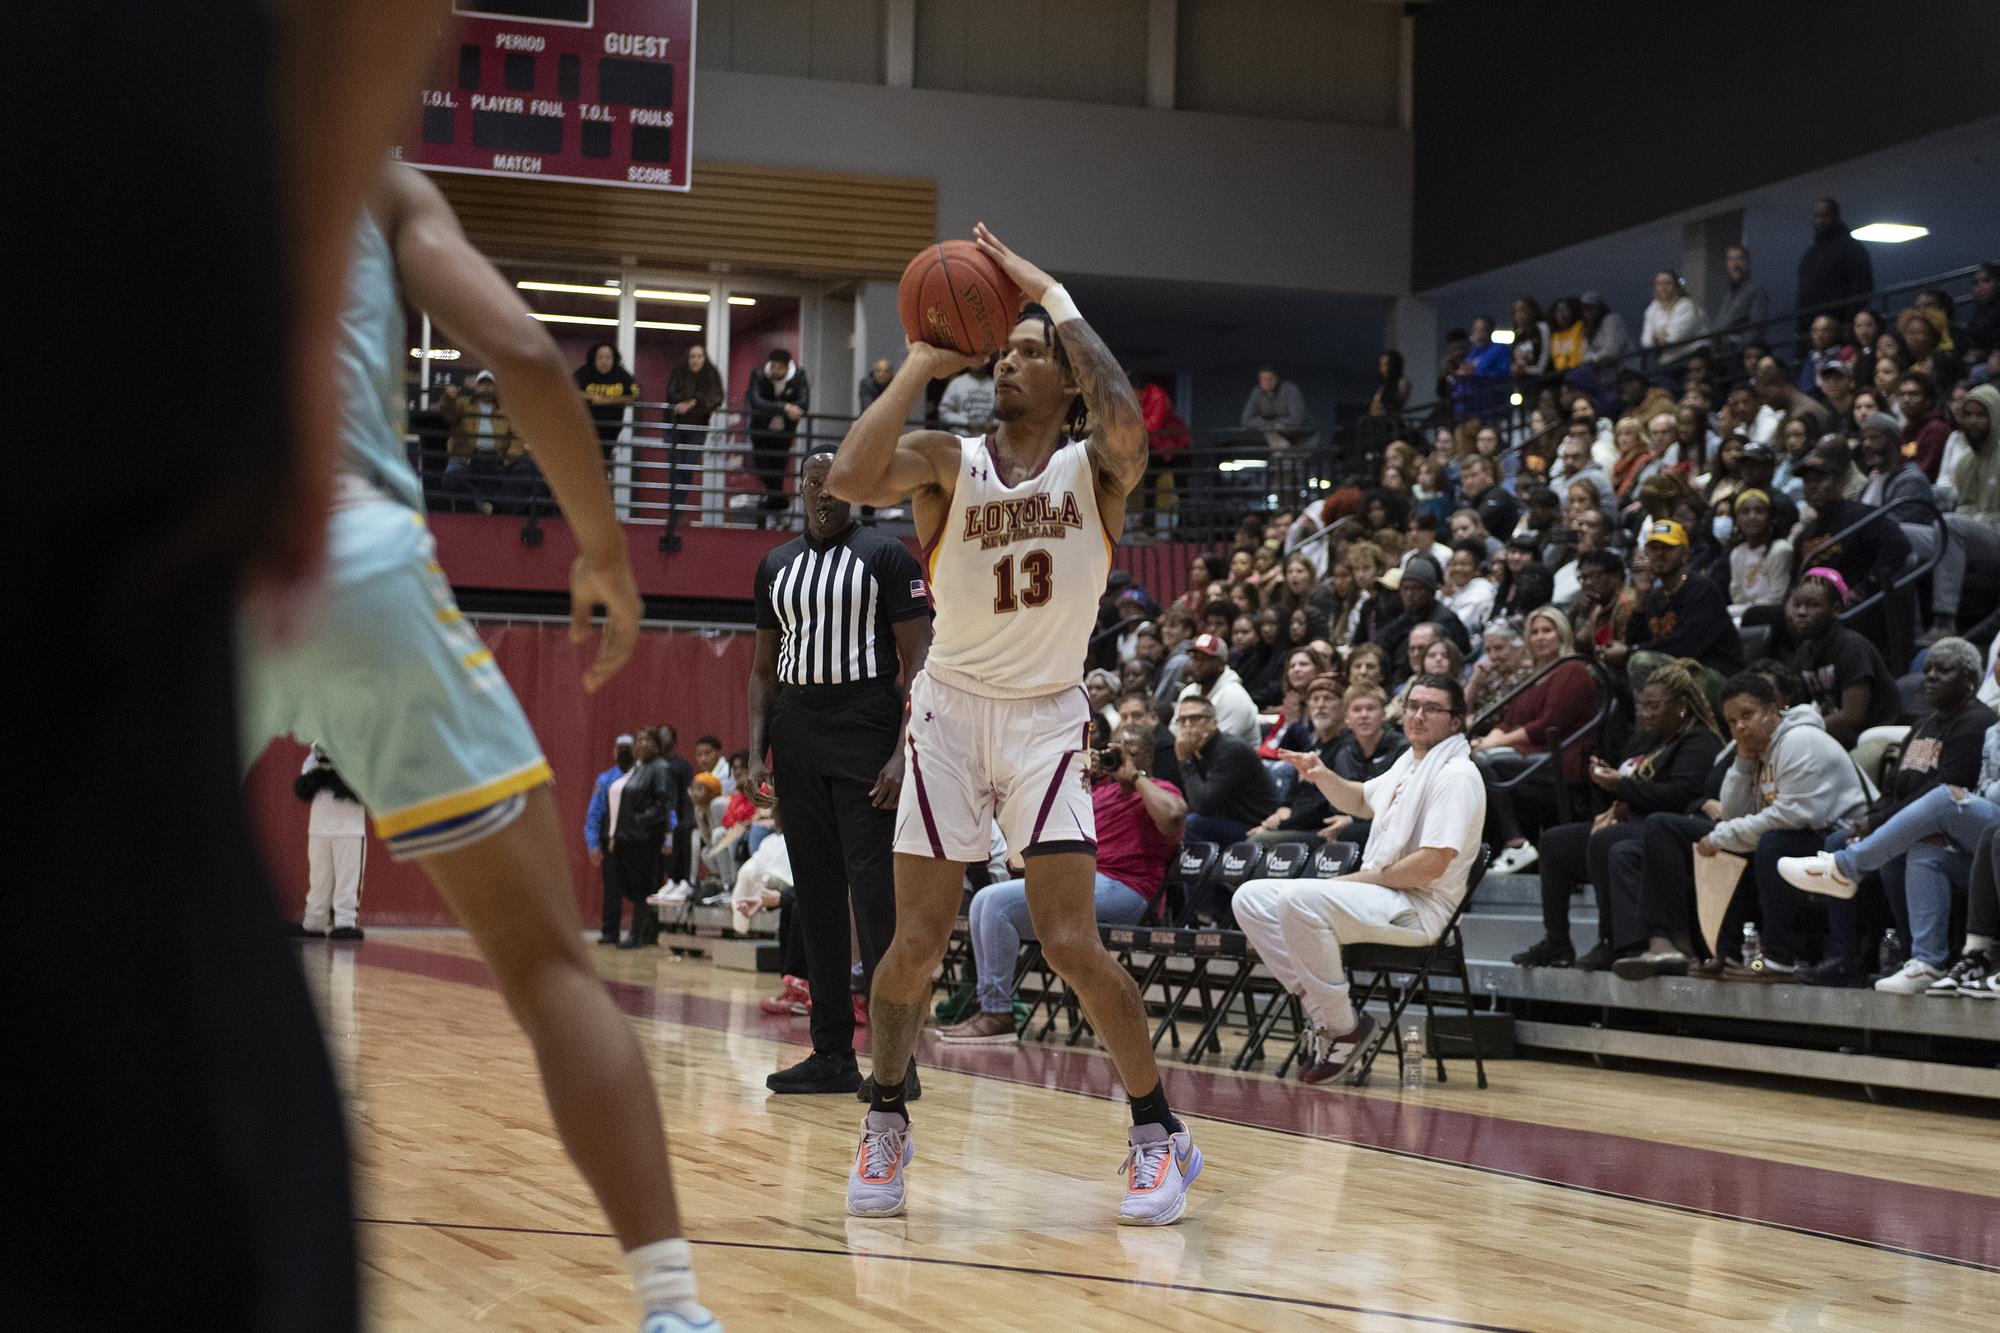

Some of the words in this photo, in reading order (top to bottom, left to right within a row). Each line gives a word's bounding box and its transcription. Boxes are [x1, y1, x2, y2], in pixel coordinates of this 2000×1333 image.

[495, 32, 546, 52] PERIOD
[604, 31, 671, 59] GUEST
[471, 94, 524, 114] PLAYER
[530, 99, 566, 118] FOUL
[578, 103, 617, 123] T.O.L.
[629, 107, 674, 128] FOULS
[493, 153, 542, 173] MATCH
[627, 165, 672, 184] SCORE
[963, 491, 1083, 542] LOYOLA
[980, 534, 1010, 550] NEW
[1012, 526, 1066, 542] ORLEANS
[993, 549, 1053, 614] 13
